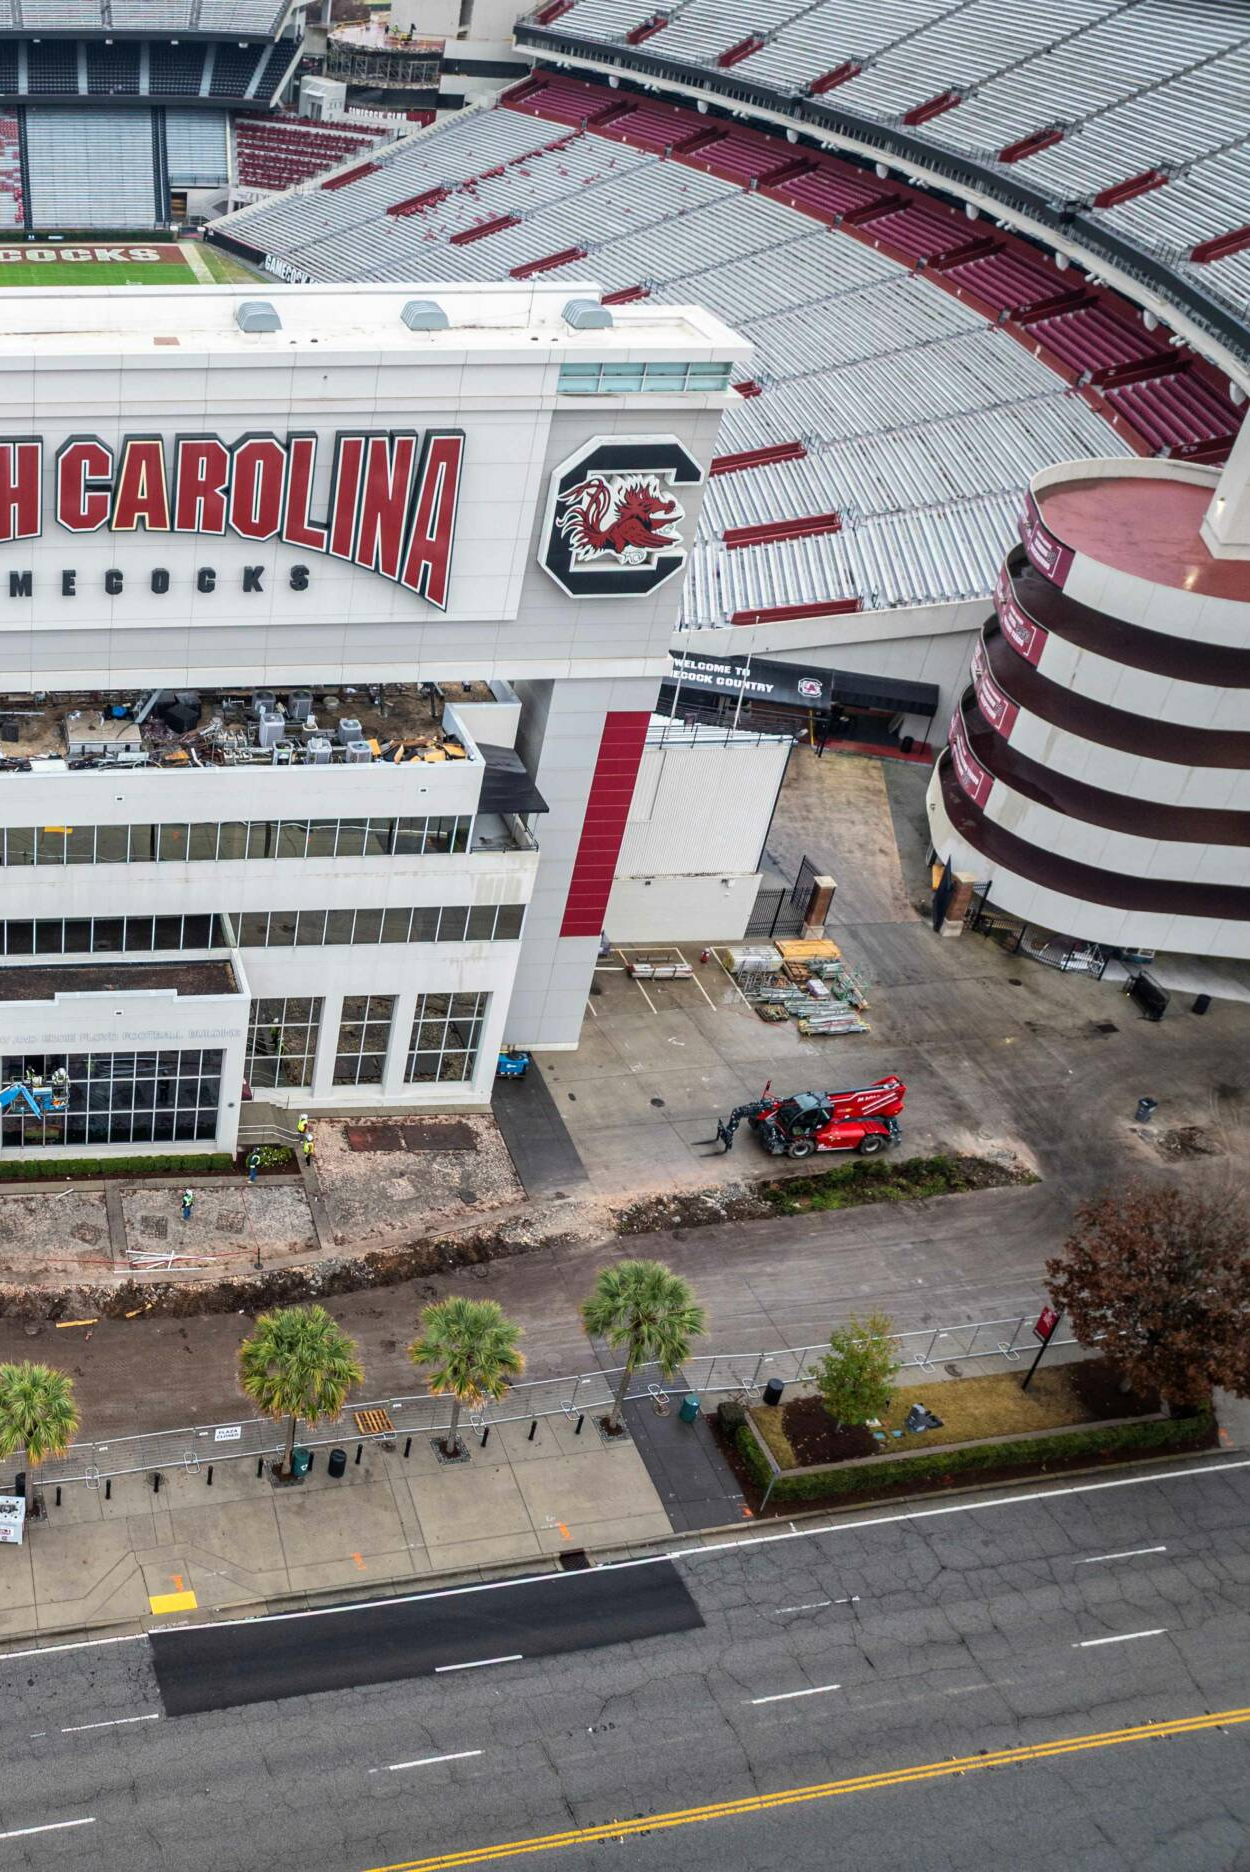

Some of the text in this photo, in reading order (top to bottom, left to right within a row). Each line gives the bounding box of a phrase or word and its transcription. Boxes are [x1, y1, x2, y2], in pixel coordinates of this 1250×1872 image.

[55, 428, 466, 613] CAROLINA
[674, 658, 751, 677] WELCOME TO
[671, 670, 775, 694] ECOCK COUNTRY
[121, 1029, 184, 1041] FOOTBALL
[188, 1026, 241, 1040] BUILDING
